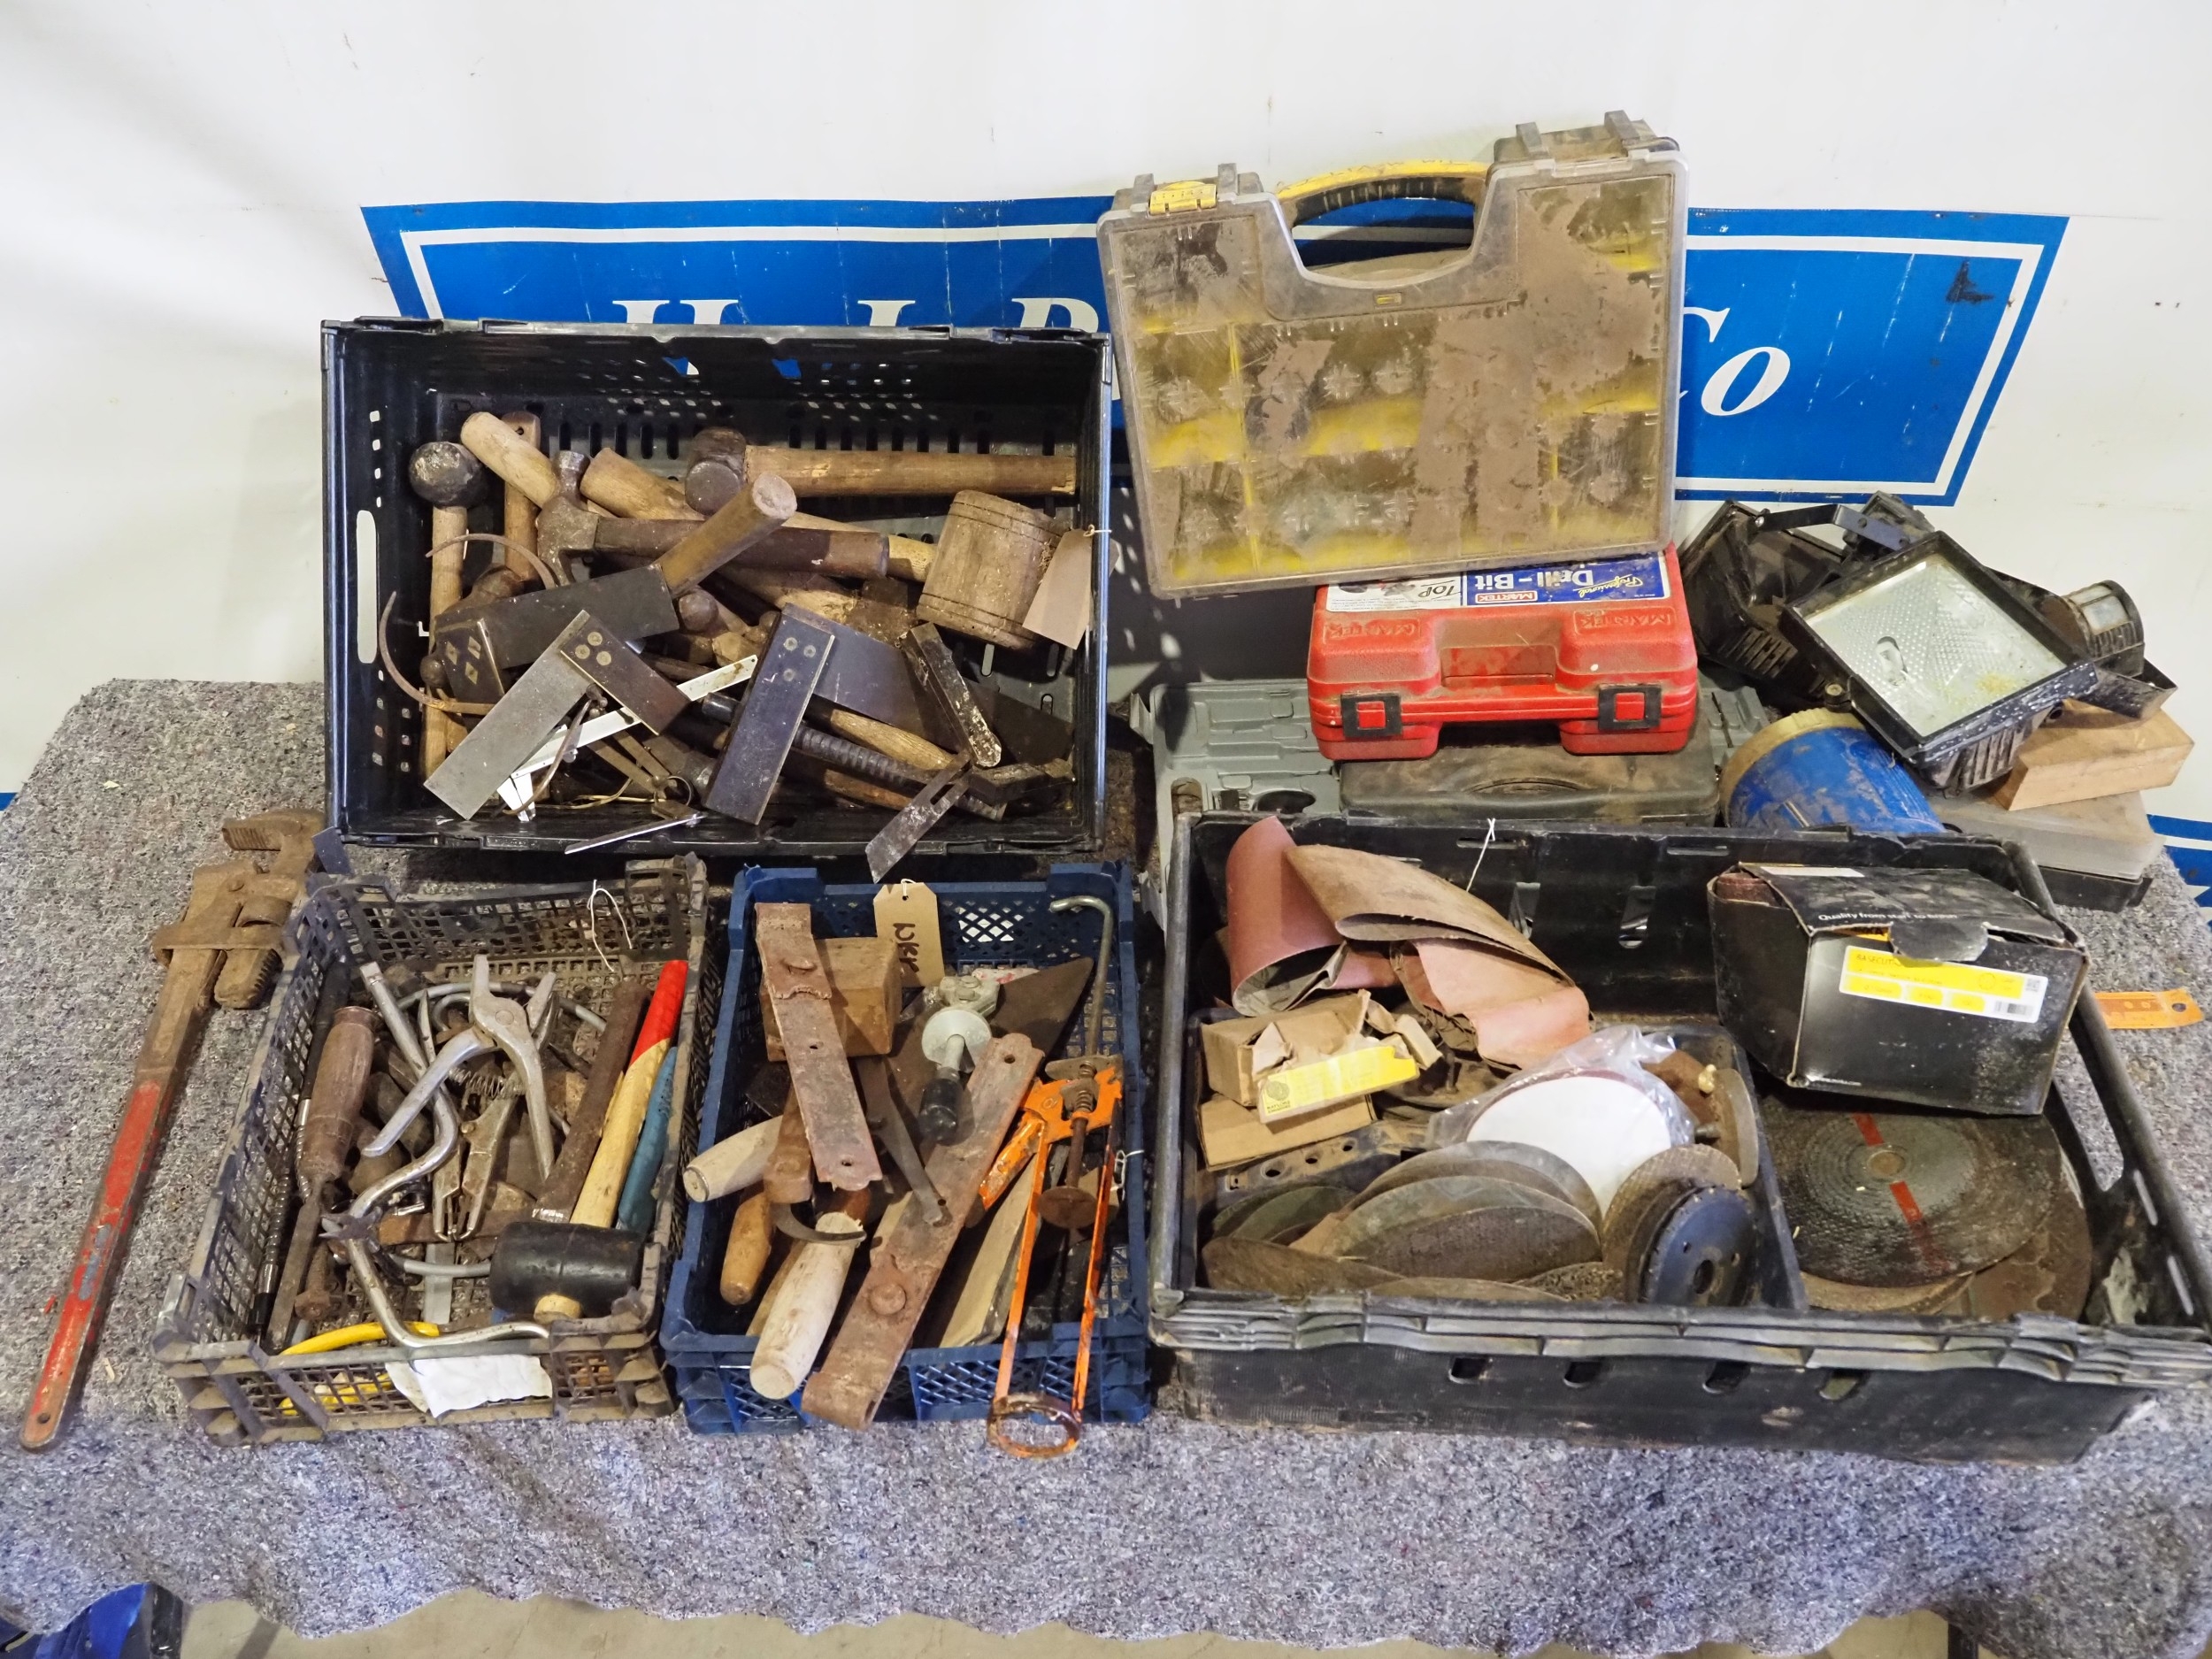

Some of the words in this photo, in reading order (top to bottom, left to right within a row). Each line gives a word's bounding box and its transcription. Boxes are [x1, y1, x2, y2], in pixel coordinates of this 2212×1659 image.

[1474, 573, 1515, 590] Bit
[1478, 592, 1533, 603] MARTEK
[1818, 912, 1857, 921] Quality
